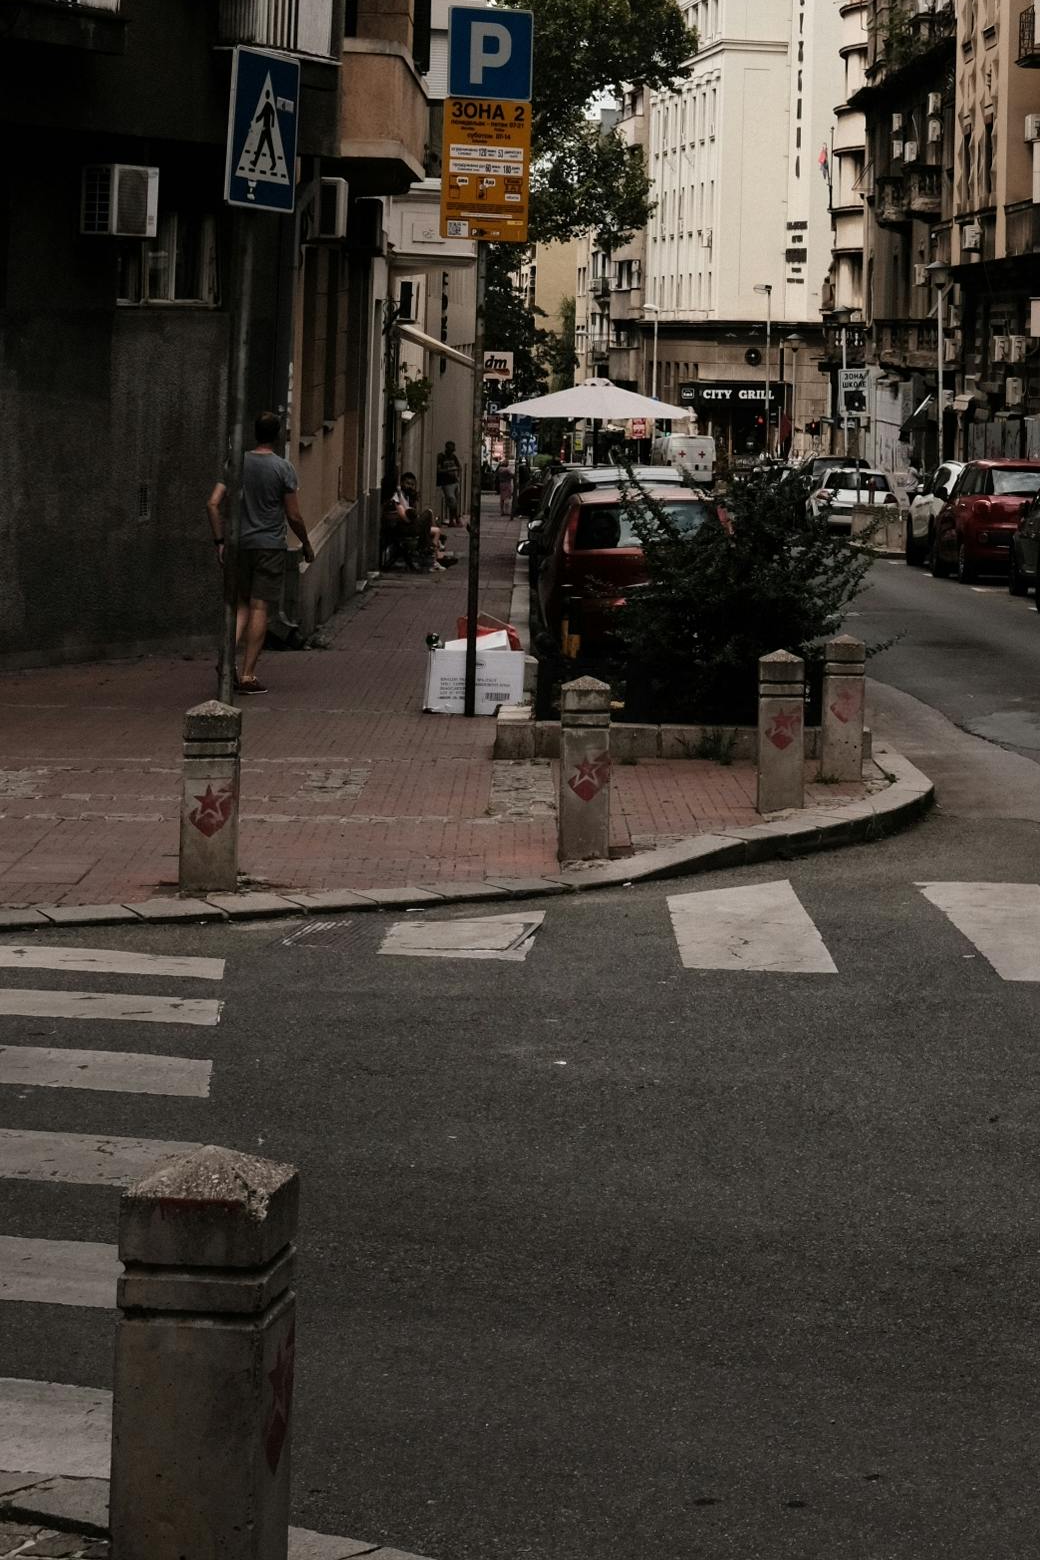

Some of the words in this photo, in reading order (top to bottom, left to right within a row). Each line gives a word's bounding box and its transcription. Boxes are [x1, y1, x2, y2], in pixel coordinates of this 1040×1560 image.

[470, 21, 513, 84] P
[452, 101, 504, 120] ЗОНА
[514, 106, 524, 121] 2
[485, 355, 507, 369] dm
[702, 389, 733, 400] CITY
